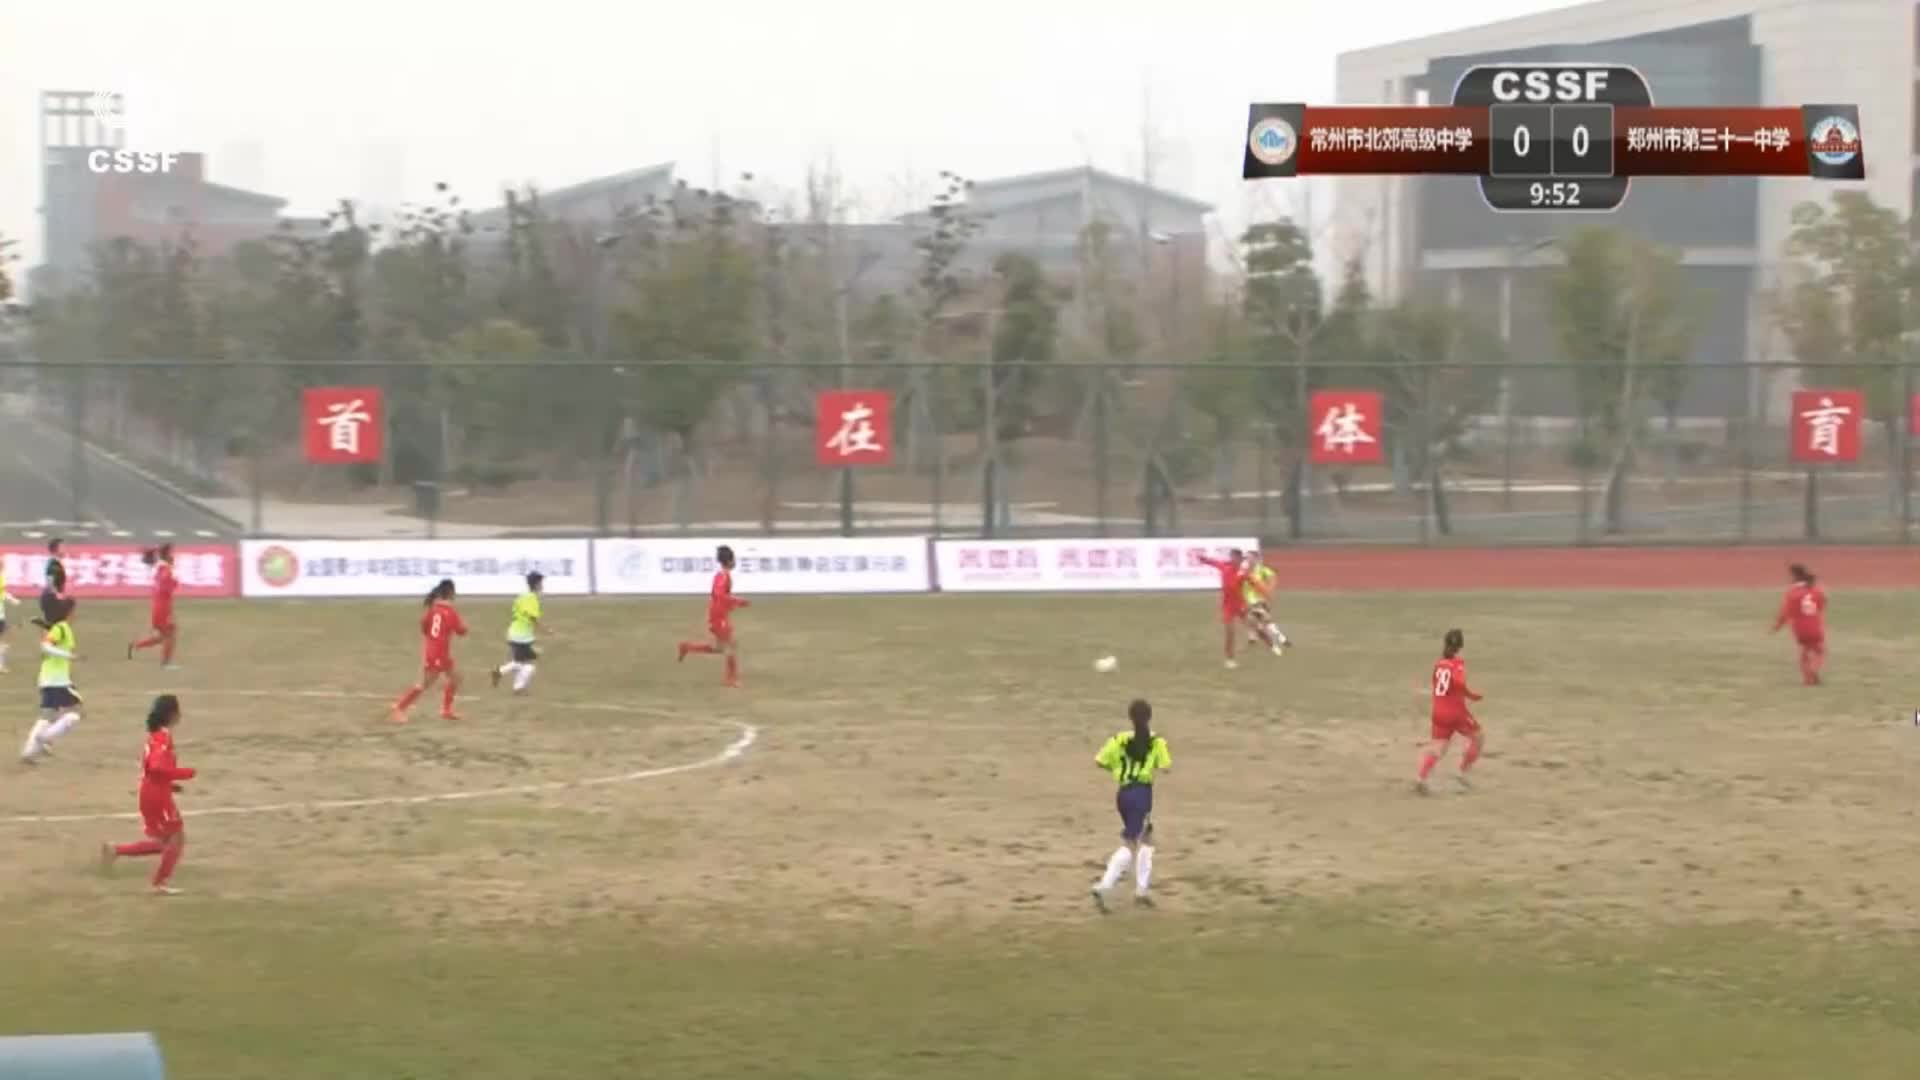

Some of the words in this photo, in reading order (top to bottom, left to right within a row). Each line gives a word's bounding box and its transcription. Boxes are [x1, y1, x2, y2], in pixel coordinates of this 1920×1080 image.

[317, 399, 371, 454] 首
[825, 401, 884, 455] 在
[1315, 402, 1376, 453] 体
[1801, 398, 1851, 454] 育
[431, 613, 442, 638] 8
